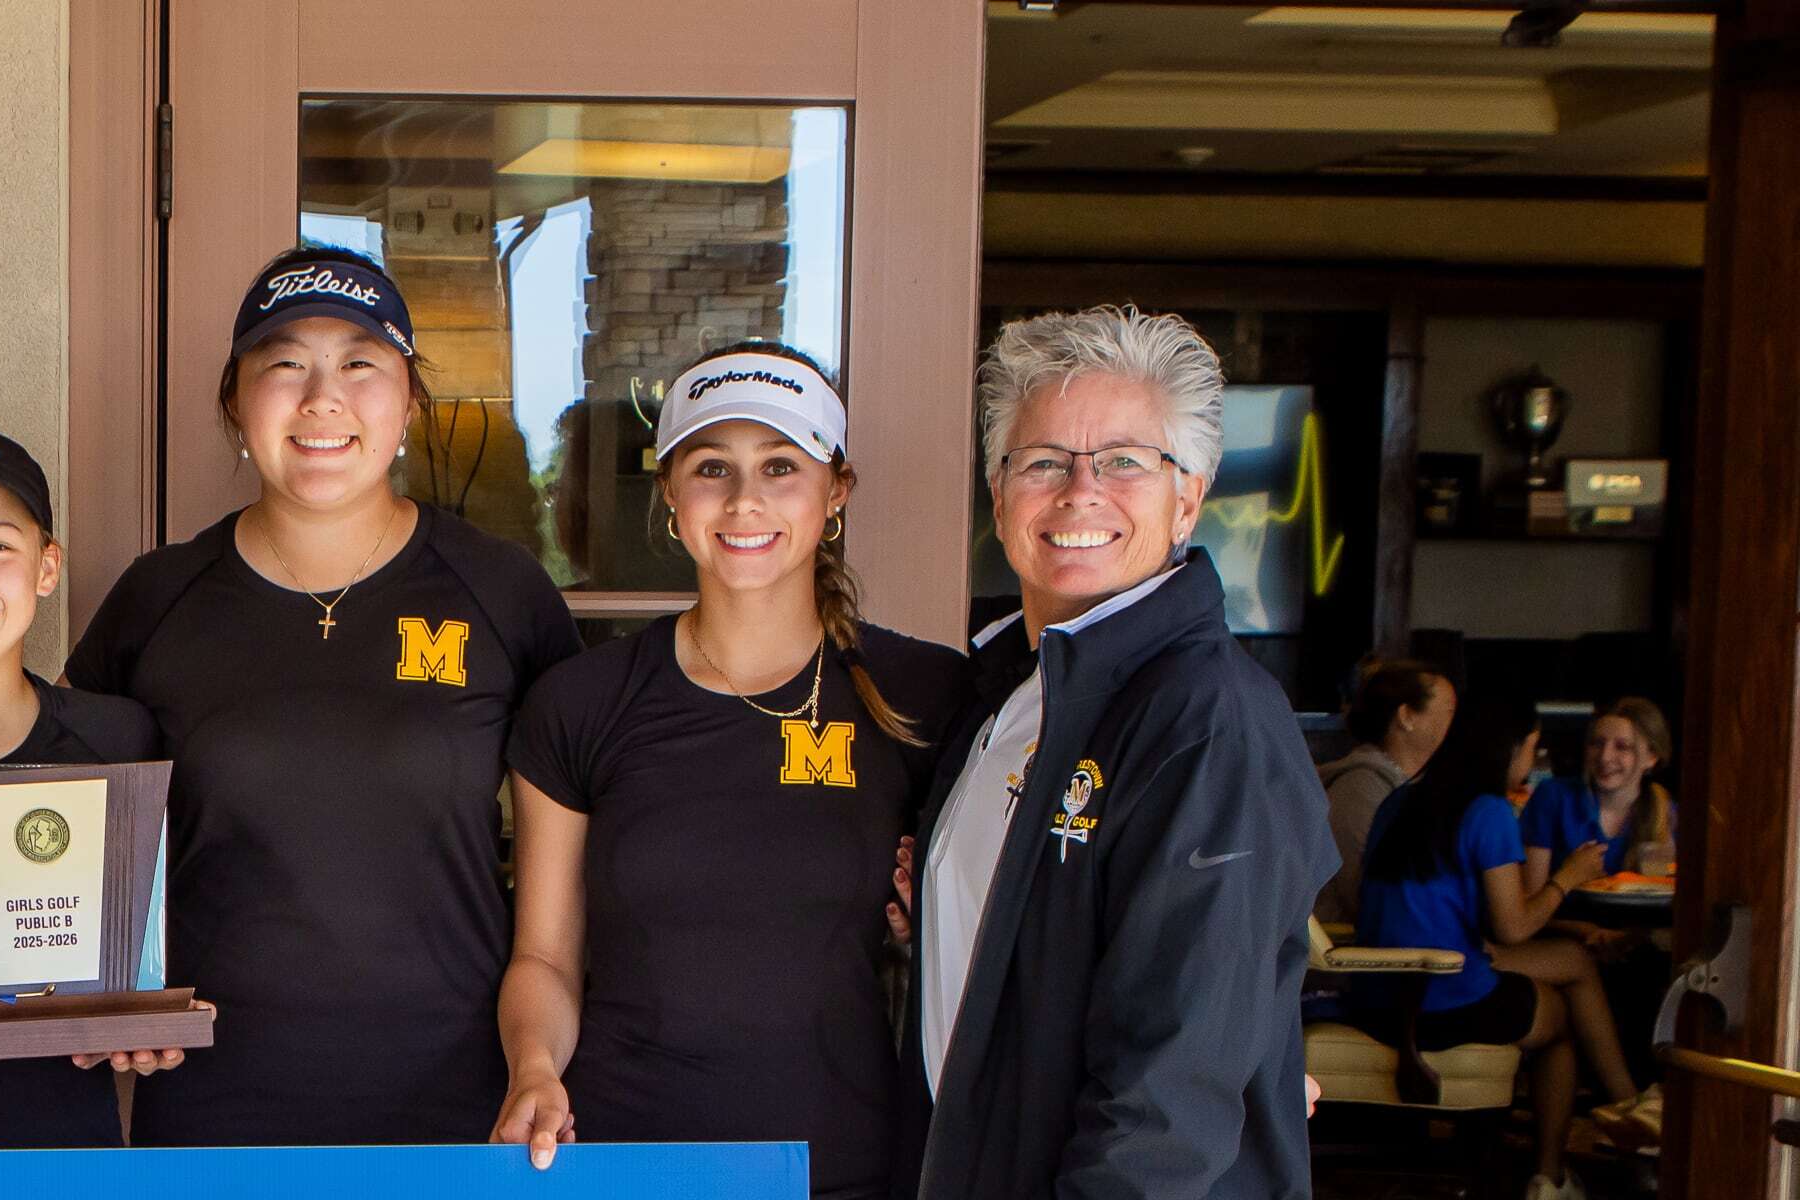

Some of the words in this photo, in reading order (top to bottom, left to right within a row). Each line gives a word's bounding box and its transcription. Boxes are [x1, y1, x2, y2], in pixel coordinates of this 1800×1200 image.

[260, 266, 380, 310] Titleist
[688, 370, 804, 400] TaylorMade
[397, 617, 469, 686] M
[780, 720, 857, 787] M
[1072, 816, 1098, 829] GOLF
[6, 898, 44, 912] GIRLS
[47, 896, 81, 910] GOLF
[15, 916, 61, 930] PUBLIC
[64, 915, 73, 928] B
[13, 933, 78, 949] 2025-2026
